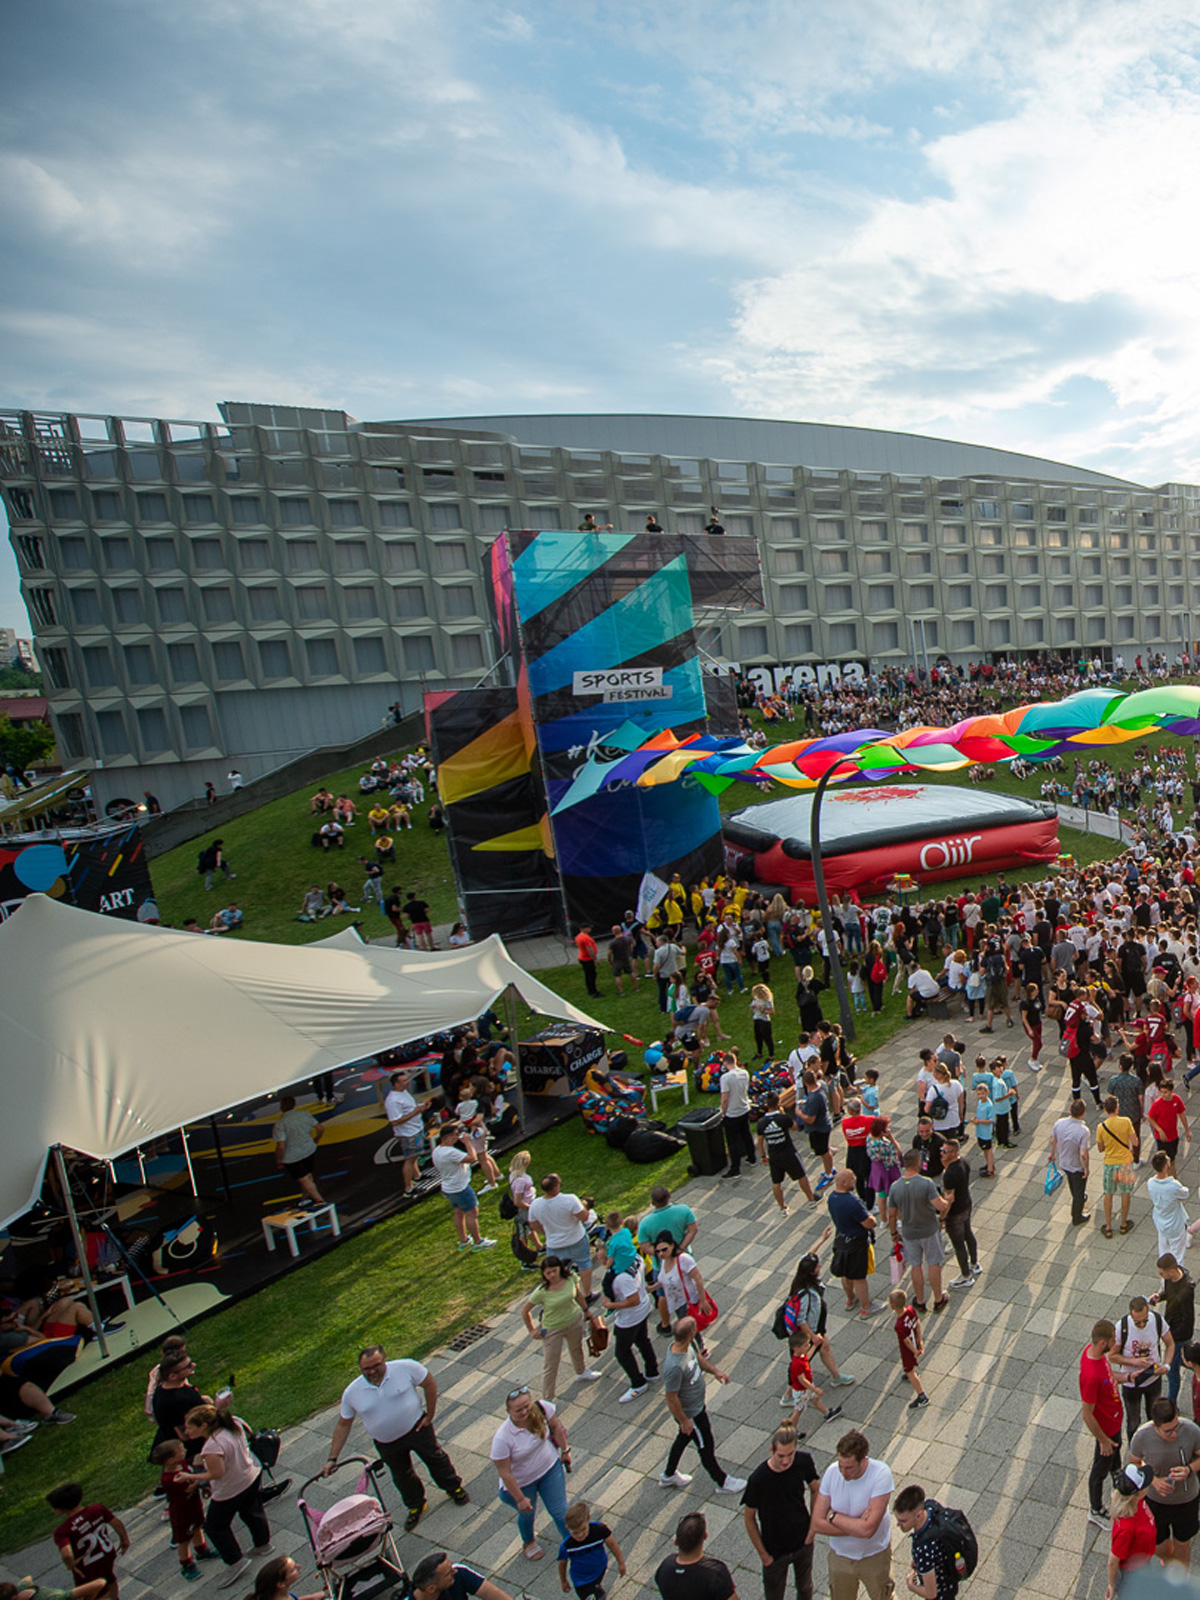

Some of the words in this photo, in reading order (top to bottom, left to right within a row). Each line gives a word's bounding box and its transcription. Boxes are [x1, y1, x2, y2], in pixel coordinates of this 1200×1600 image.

[581, 671, 655, 688] SPORTS
[748, 662, 865, 698] arena
[609, 687, 668, 701] FESTIVAL
[920, 834, 981, 871] aiir
[100, 888, 135, 912] ART
[524, 1065, 562, 1076] CHARGE
[570, 1047, 603, 1072] CHARGE
